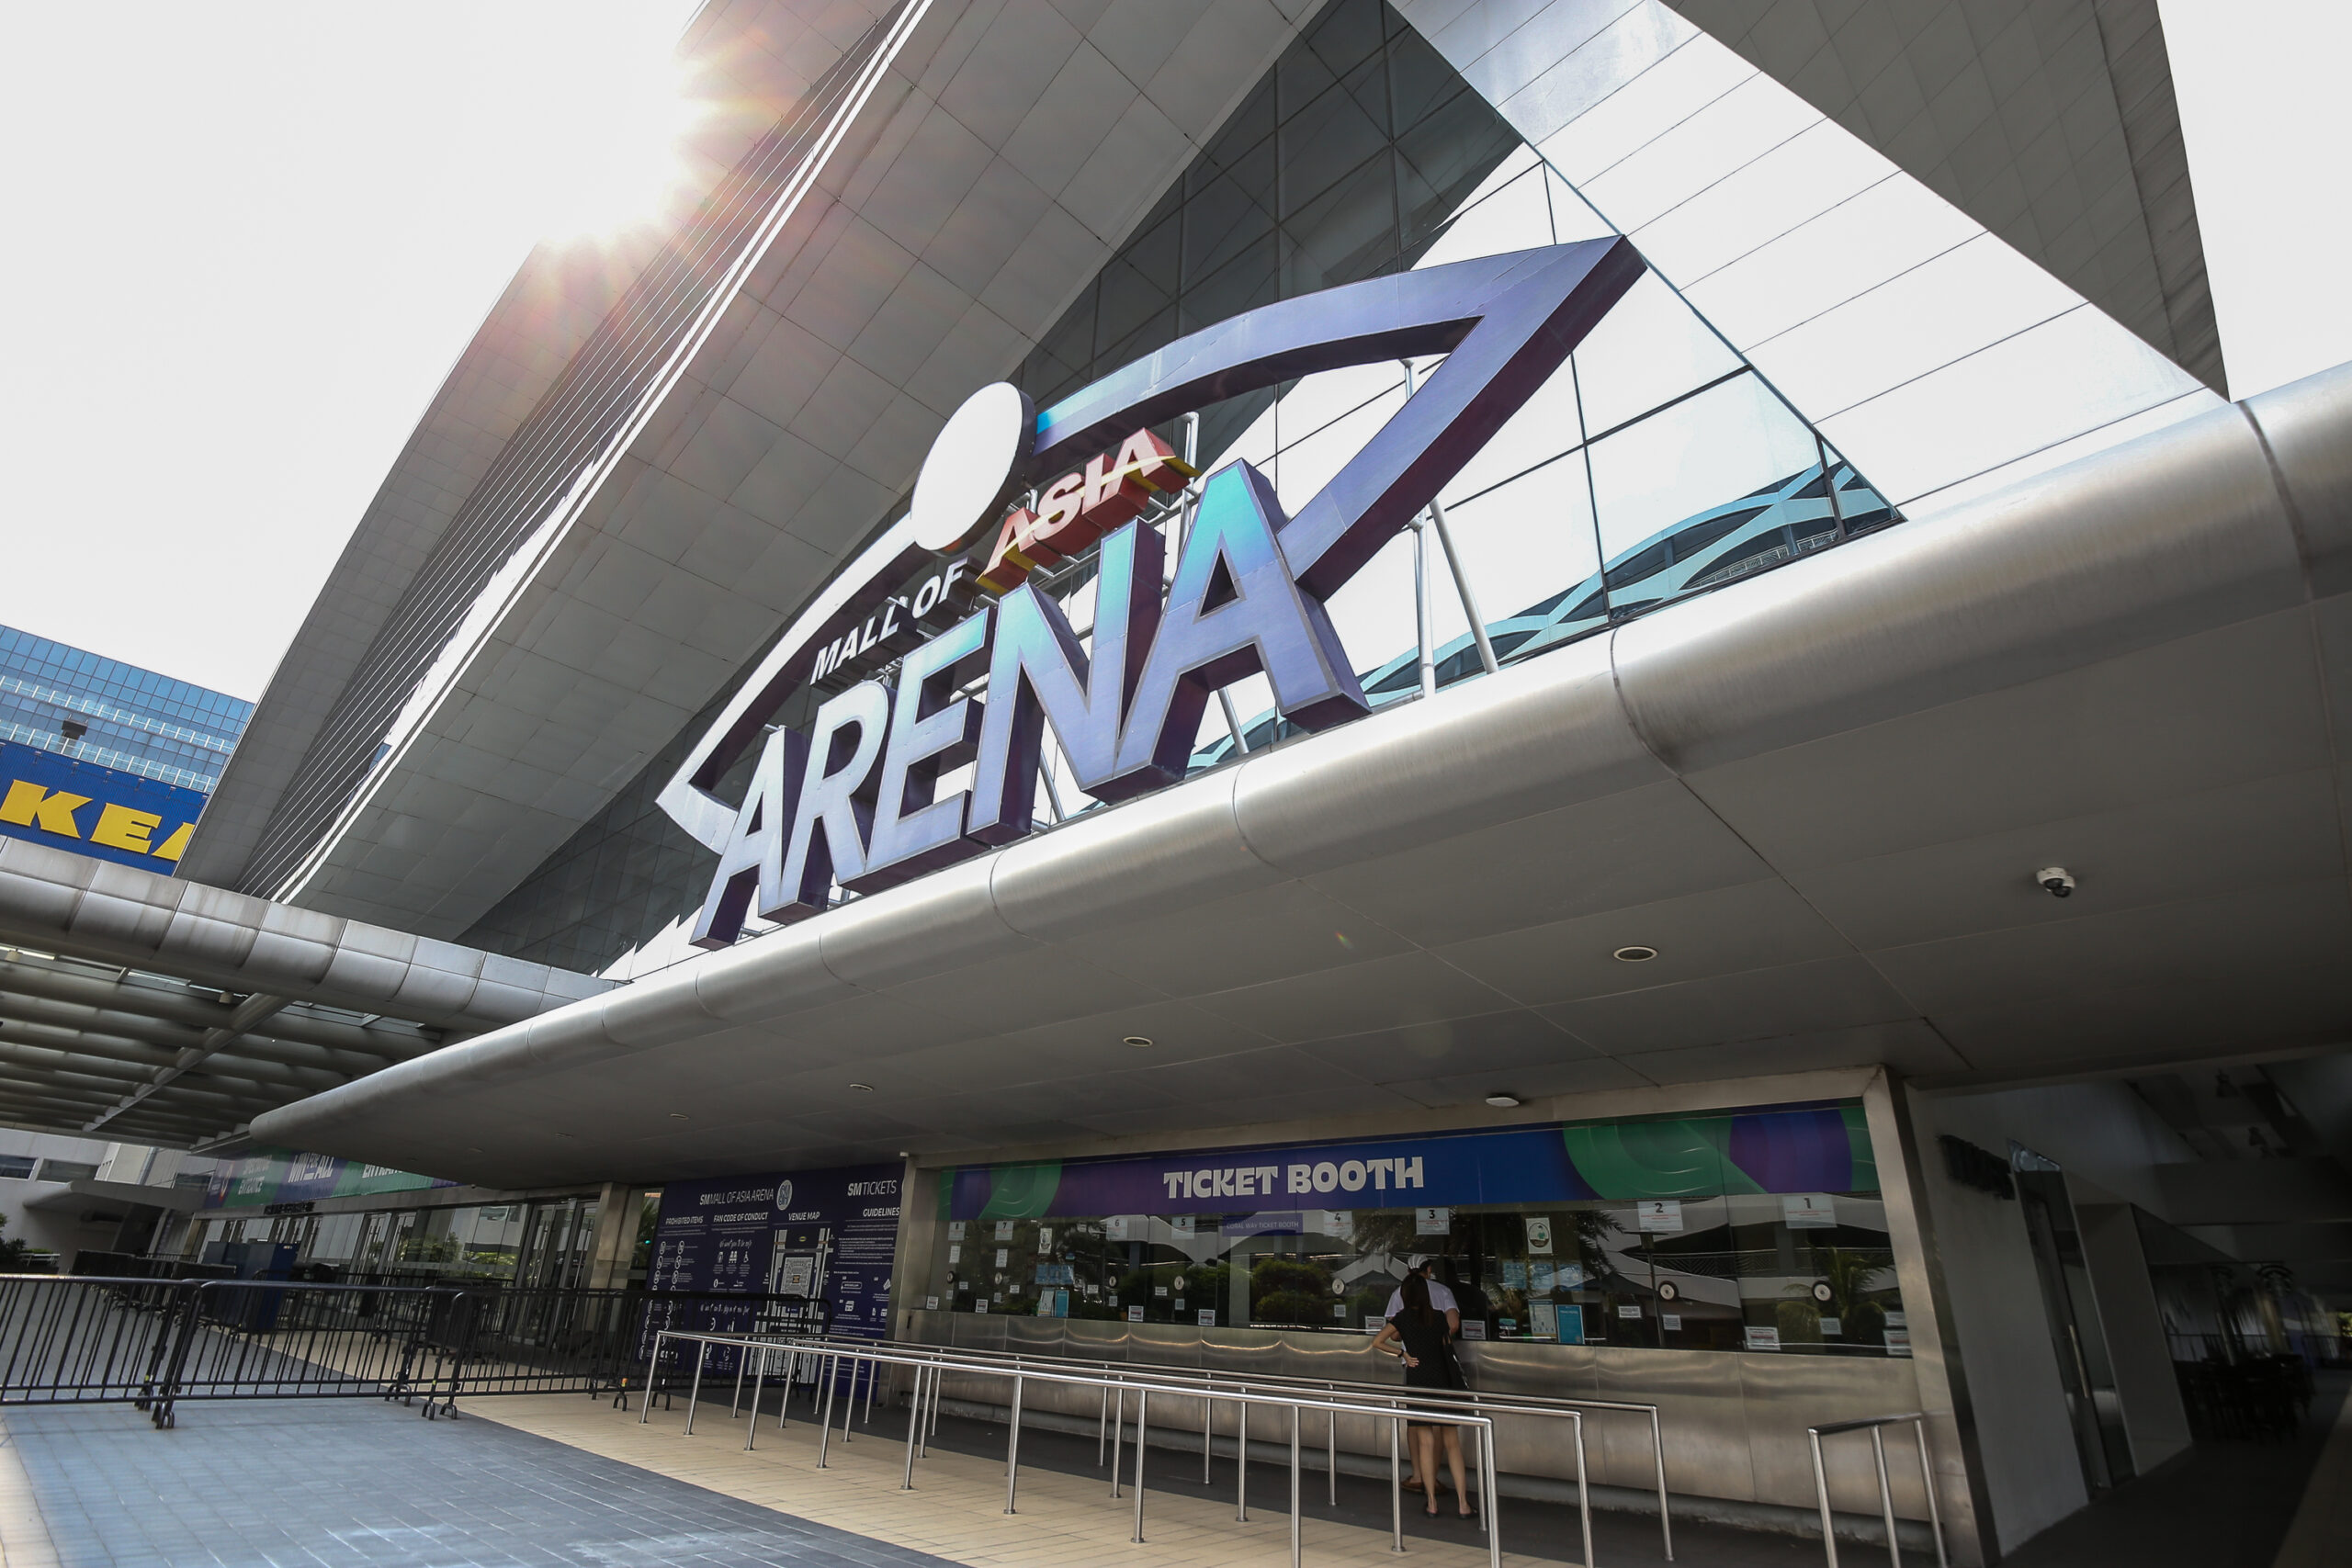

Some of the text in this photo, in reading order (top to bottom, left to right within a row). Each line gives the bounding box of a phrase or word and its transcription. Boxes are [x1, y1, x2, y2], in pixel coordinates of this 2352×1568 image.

[808, 427, 1182, 686] MALL OF ASIA
[688, 457, 1352, 950] ARENA
[314, 1155, 334, 1179] ALL
[1163, 1156, 1424, 1199] TICKET BOOTH
[726, 1191, 735, 1203] OF
[735, 1190, 751, 1202] ASIA
[751, 1188, 775, 1201] ARENA
[1655, 1202, 1664, 1213] 2
[1804, 1197, 1812, 1209] 1
[788, 1211, 820, 1221] VENUE MAP
[863, 1206, 900, 1217] GUIDELINES
[1429, 1209, 1436, 1219] 3
[665, 1215, 704, 1225] PROHIBITED ITEMS
[713, 1212, 769, 1223] FAN CODE OF CONDUCT
[1181, 1218, 1186, 1226] 5
[1334, 1213, 1341, 1222] 4
